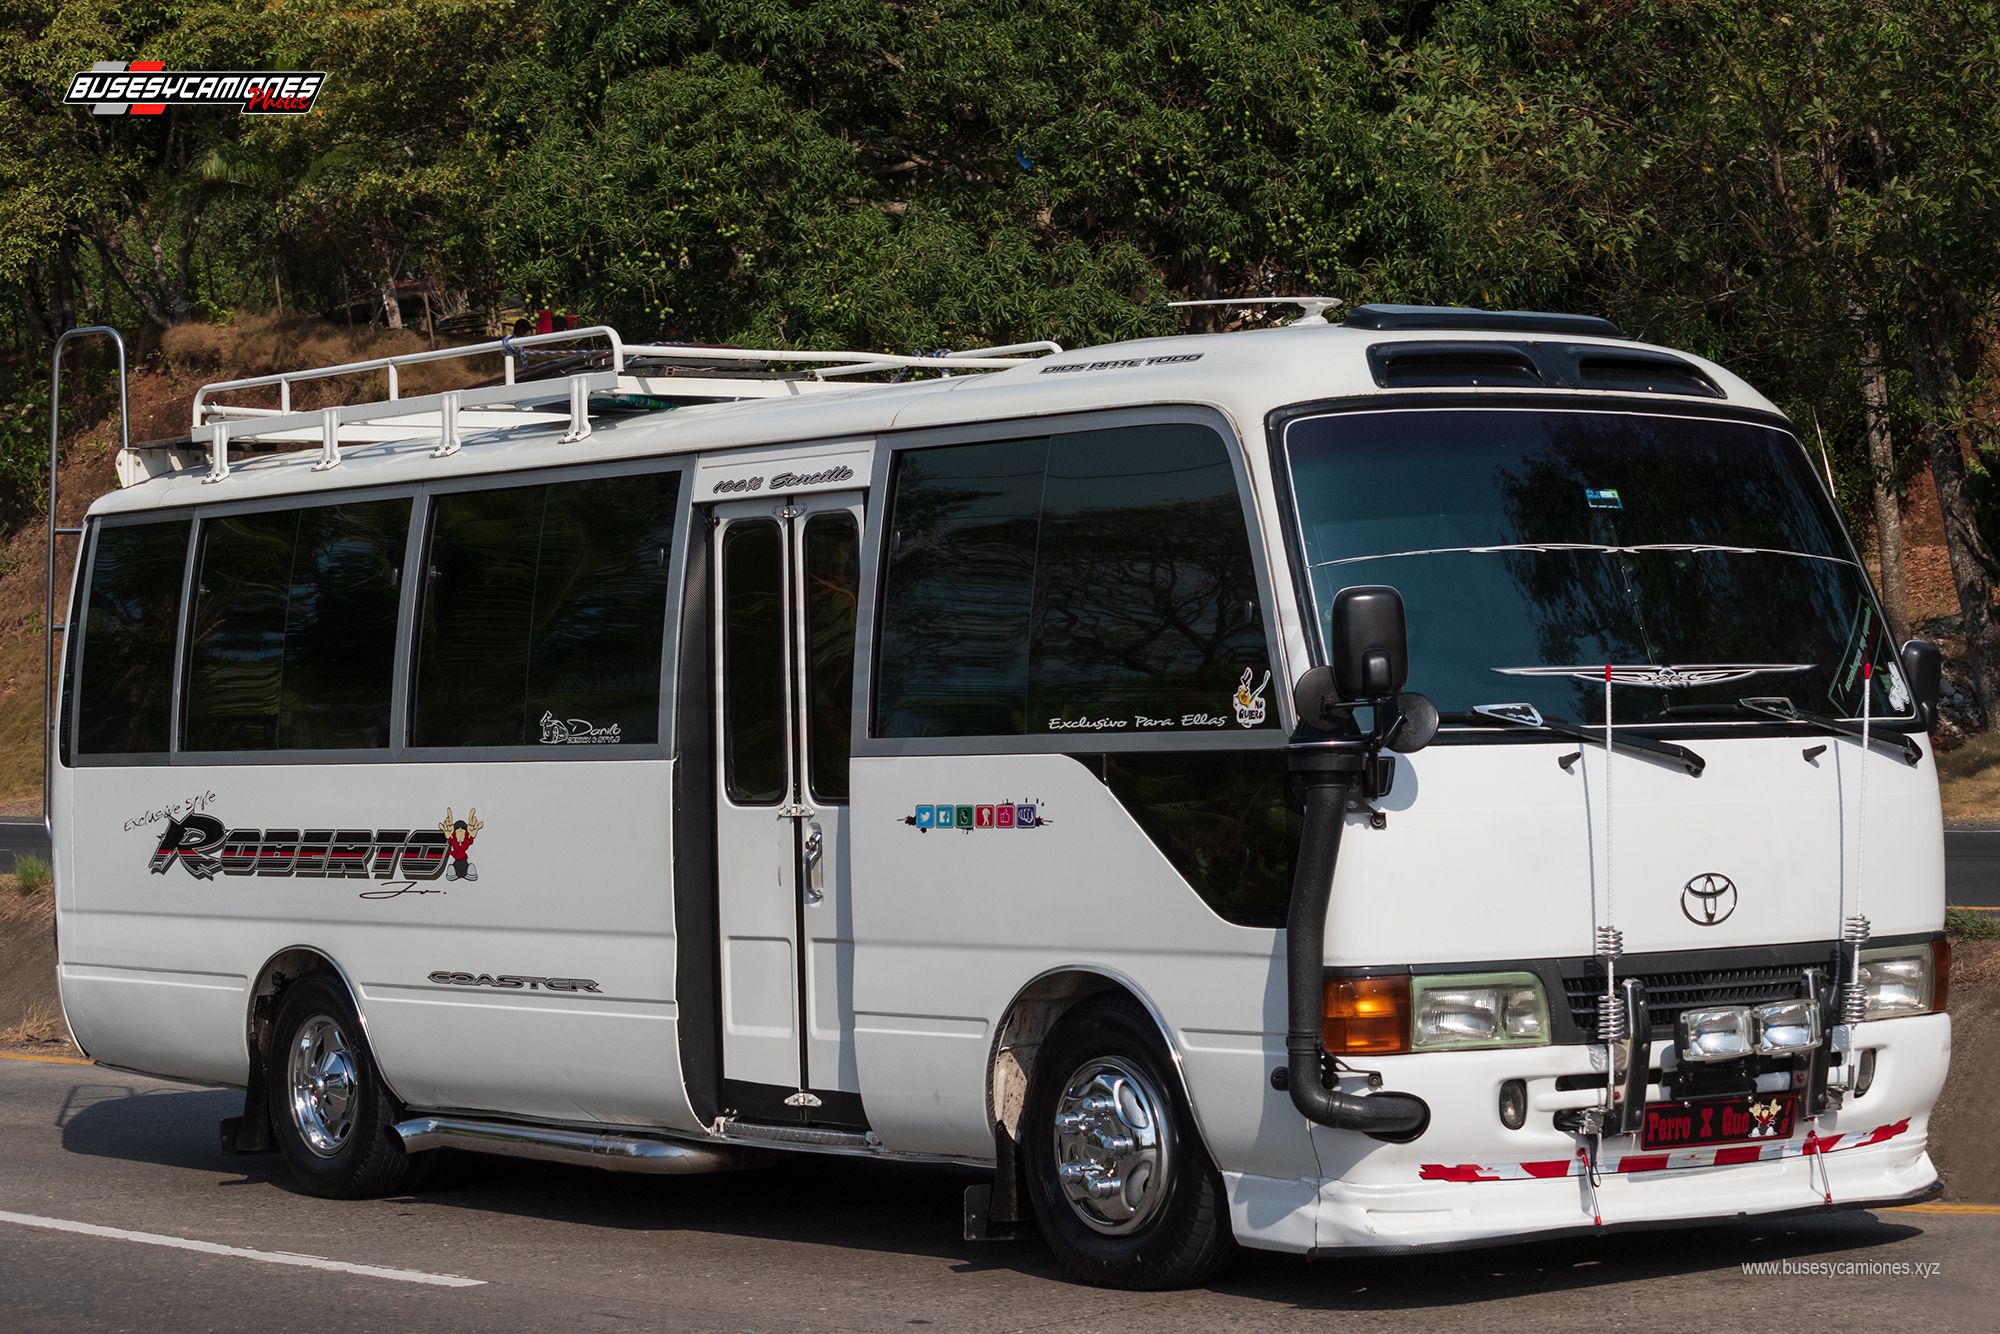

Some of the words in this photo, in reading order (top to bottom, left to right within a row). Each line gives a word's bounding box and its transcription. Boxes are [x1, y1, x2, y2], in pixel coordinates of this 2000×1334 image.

[1039, 362, 1091, 375] DIOS
[1145, 353, 1205, 367] TODO
[1049, 717, 1128, 730] Exclusivo
[1134, 715, 1175, 728] Para
[1181, 713, 1228, 727] Ellas
[427, 971, 603, 994] COASTER
[1647, 1112, 1692, 1143] Perro
[1700, 1107, 1714, 1138] X
[1721, 1105, 1750, 1137] Que
